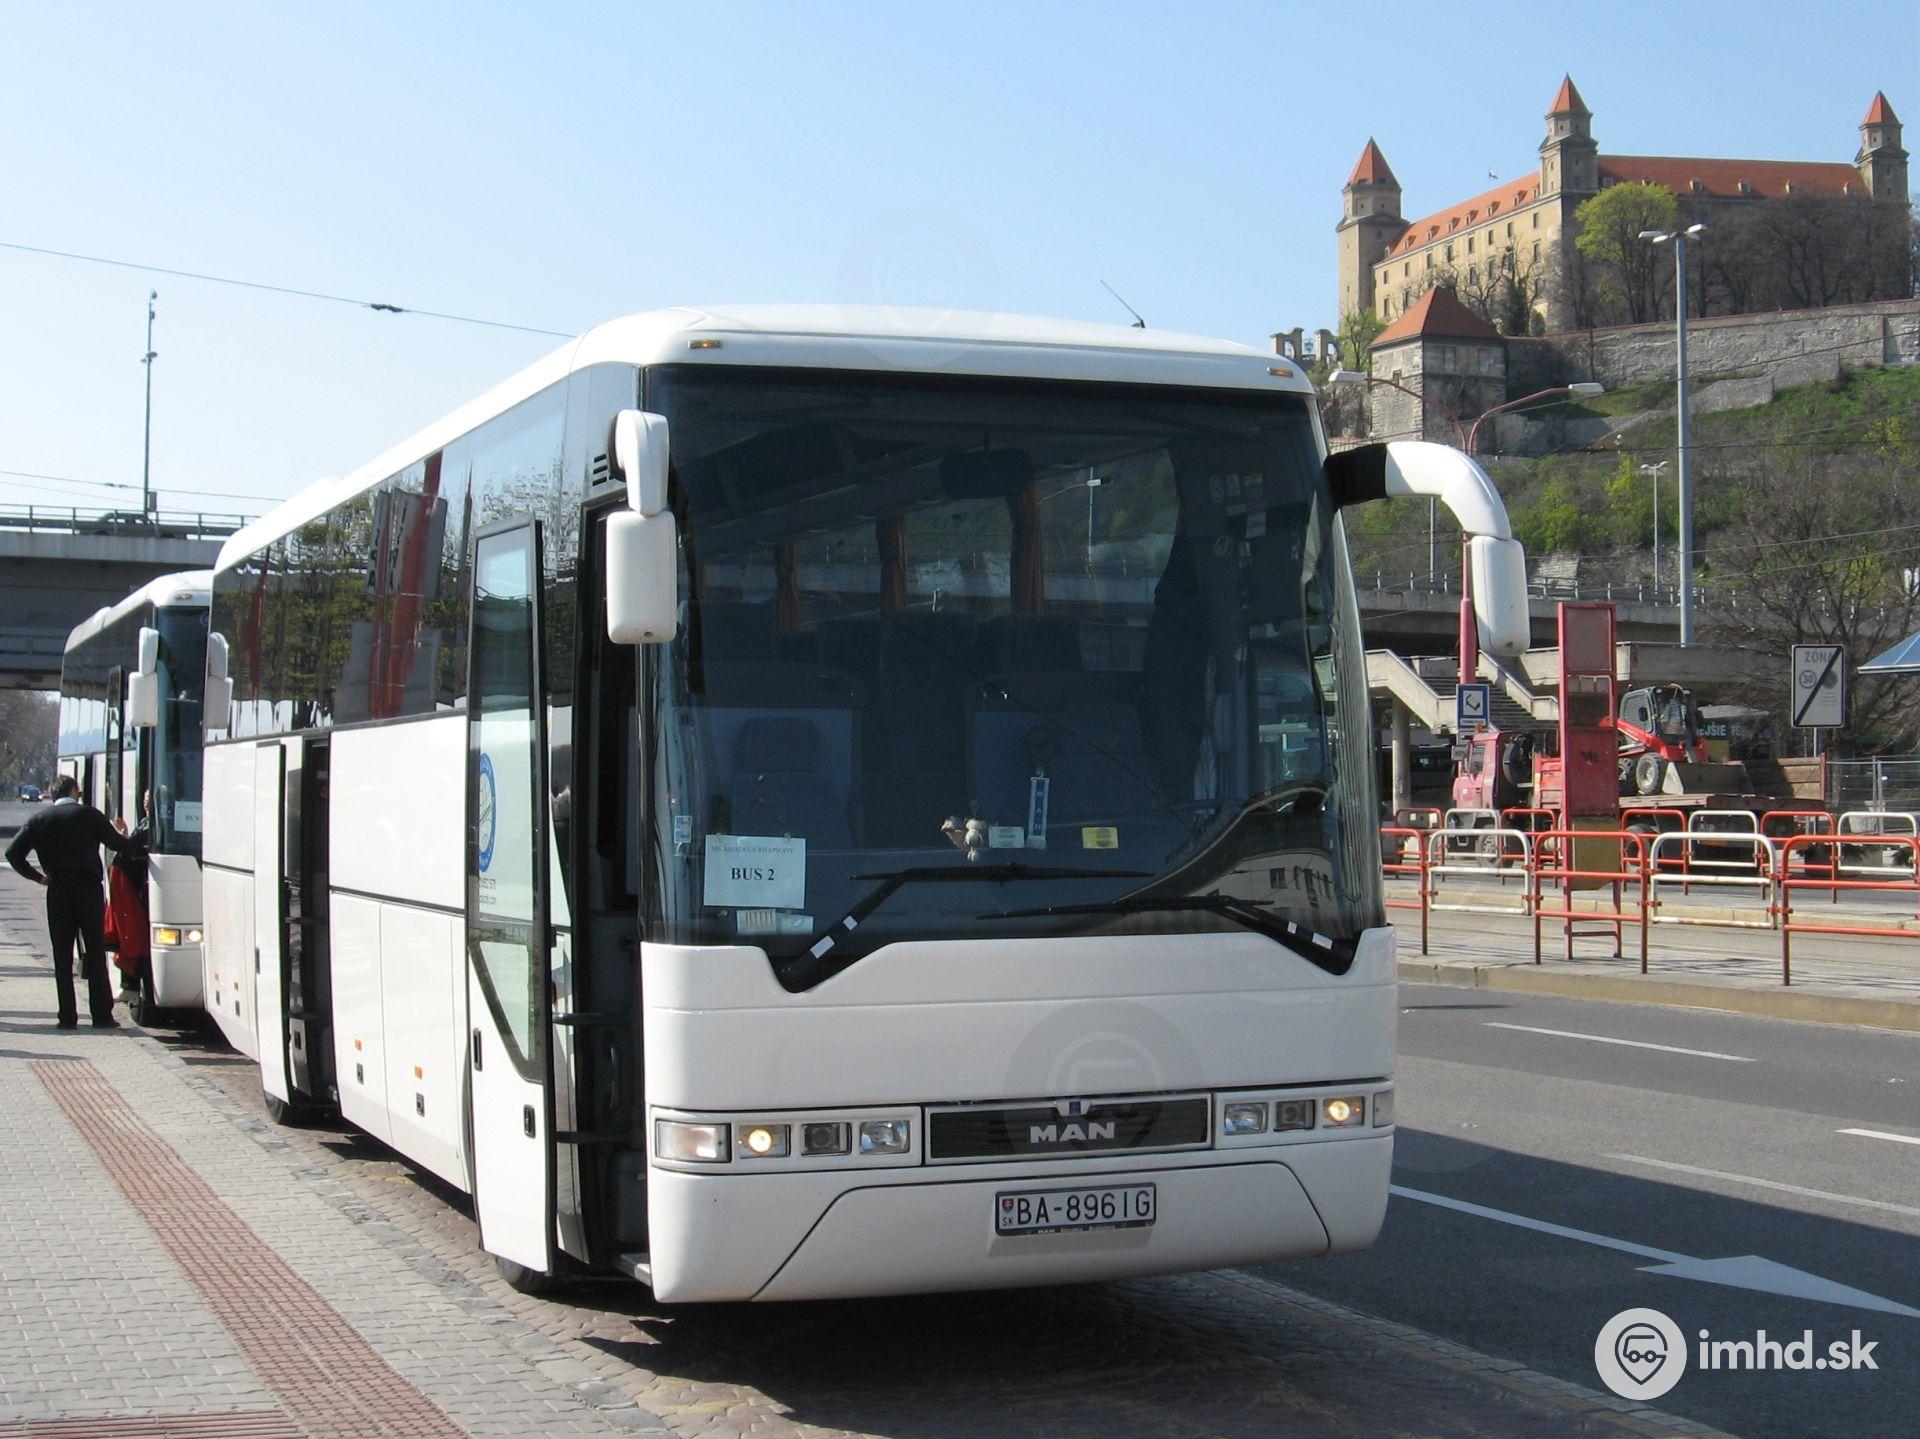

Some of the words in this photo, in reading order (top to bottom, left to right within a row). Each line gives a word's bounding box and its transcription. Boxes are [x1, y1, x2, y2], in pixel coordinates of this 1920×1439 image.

[1803, 674, 1814, 684] 30
[731, 867, 763, 881] BUS
[767, 868, 775, 881] 2
[1030, 1122, 1115, 1144] MAN
[1002, 1217, 1014, 1227] SK
